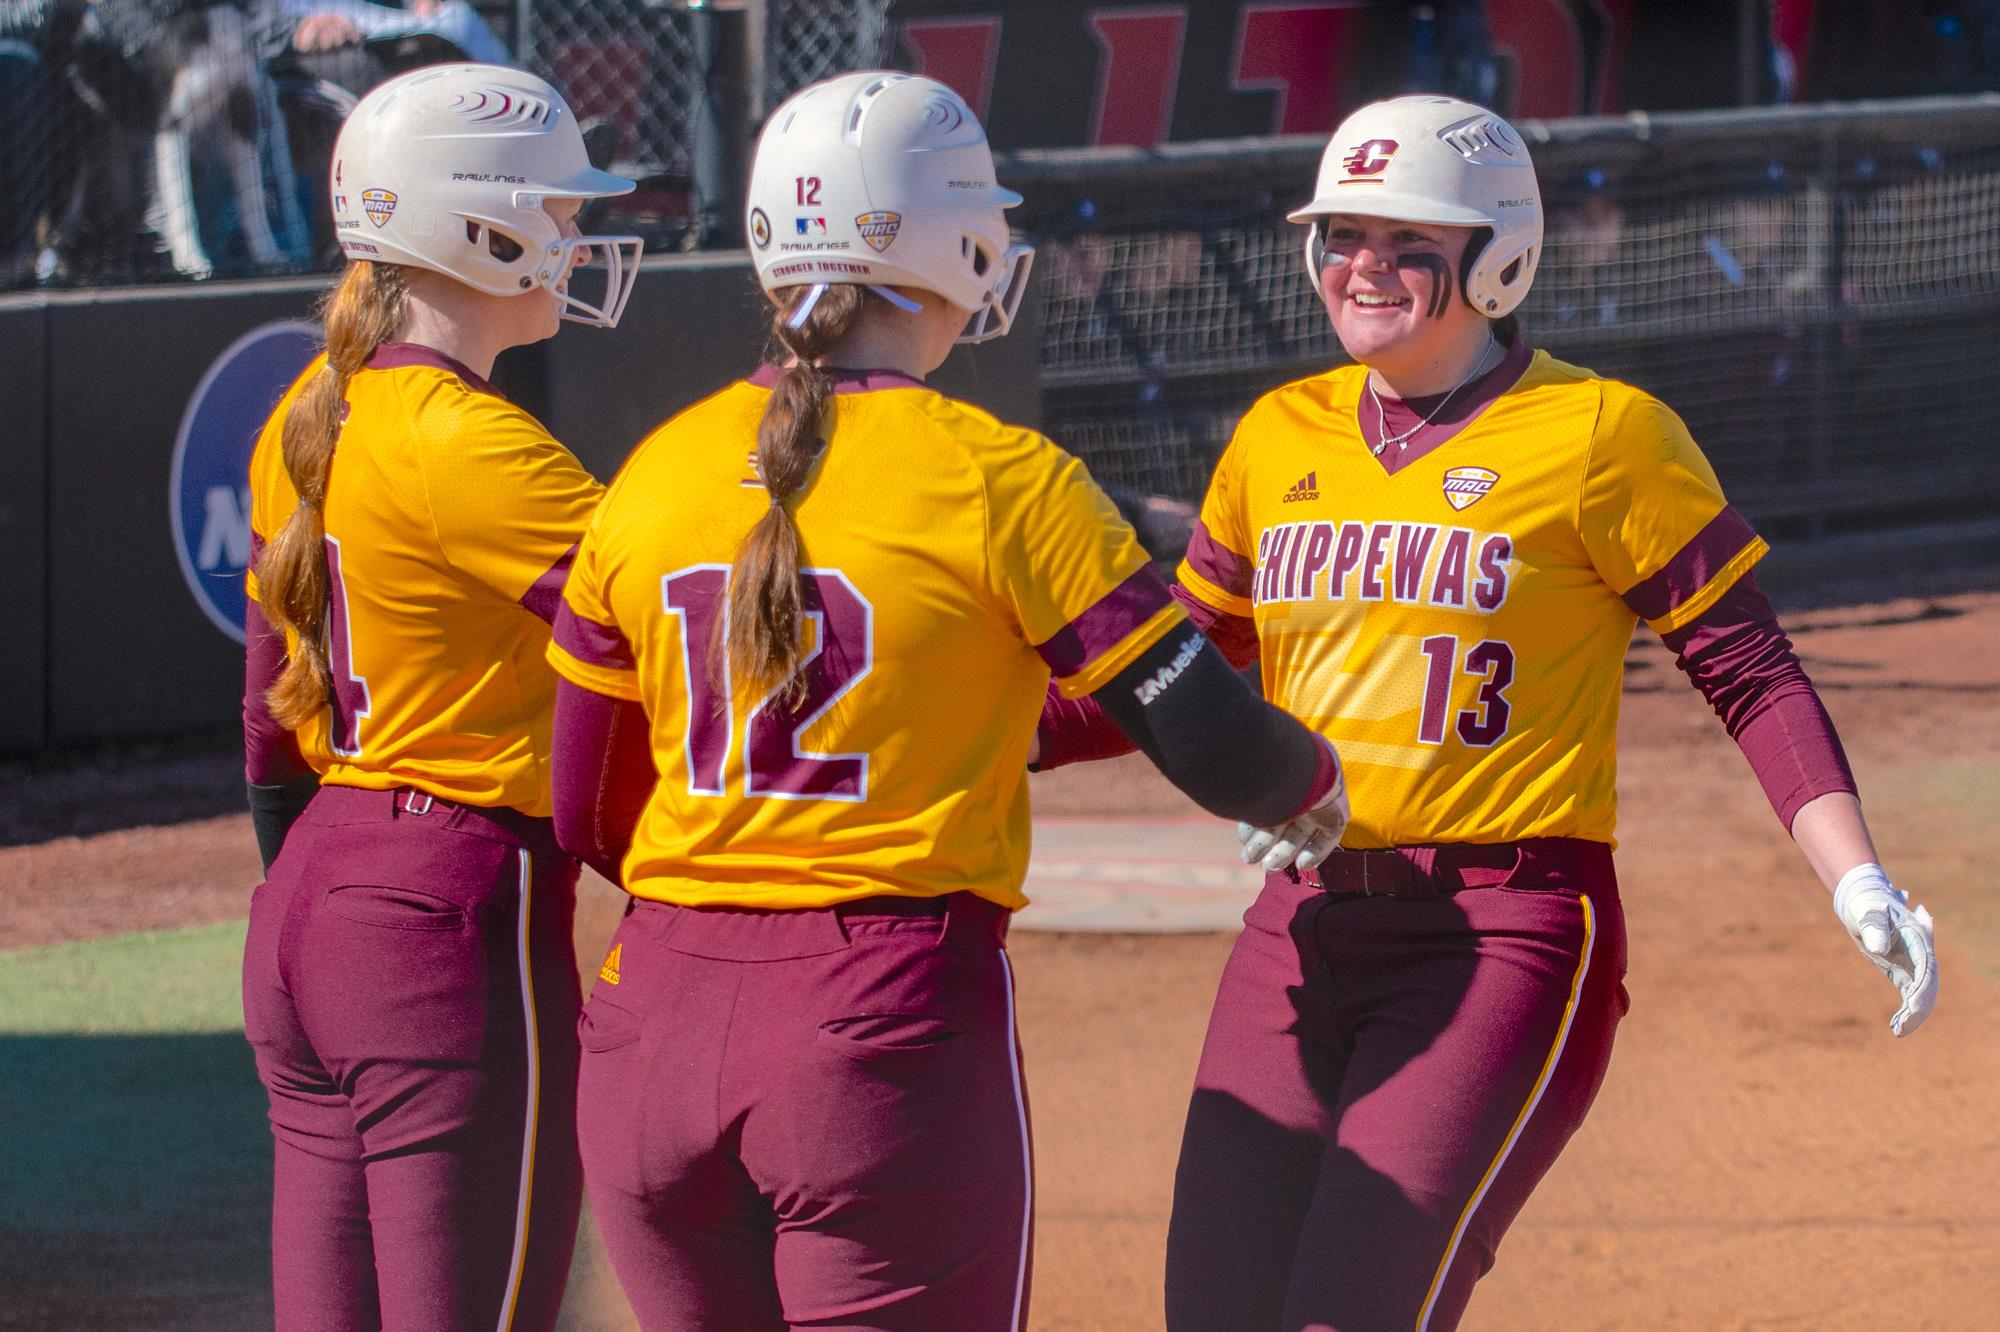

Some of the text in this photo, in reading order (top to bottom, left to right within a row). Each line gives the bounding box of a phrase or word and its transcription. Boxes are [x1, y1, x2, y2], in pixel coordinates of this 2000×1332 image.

[335, 159, 342, 188] 4
[452, 173, 527, 184] RAWLINGS
[795, 176, 822, 207] 12
[366, 199, 395, 214] MAC
[859, 222, 900, 236] MAC
[780, 241, 850, 251] RAWLINGS
[773, 262, 871, 278] STRONGER TOGETHER
[1443, 478, 1494, 493] MAC
[1282, 490, 1320, 503] adidas
[1252, 520, 1514, 614] CHIPPEWAS
[1142, 631, 1207, 697] Mueller
[661, 563, 874, 802] 12
[1417, 633, 1515, 748] 13
